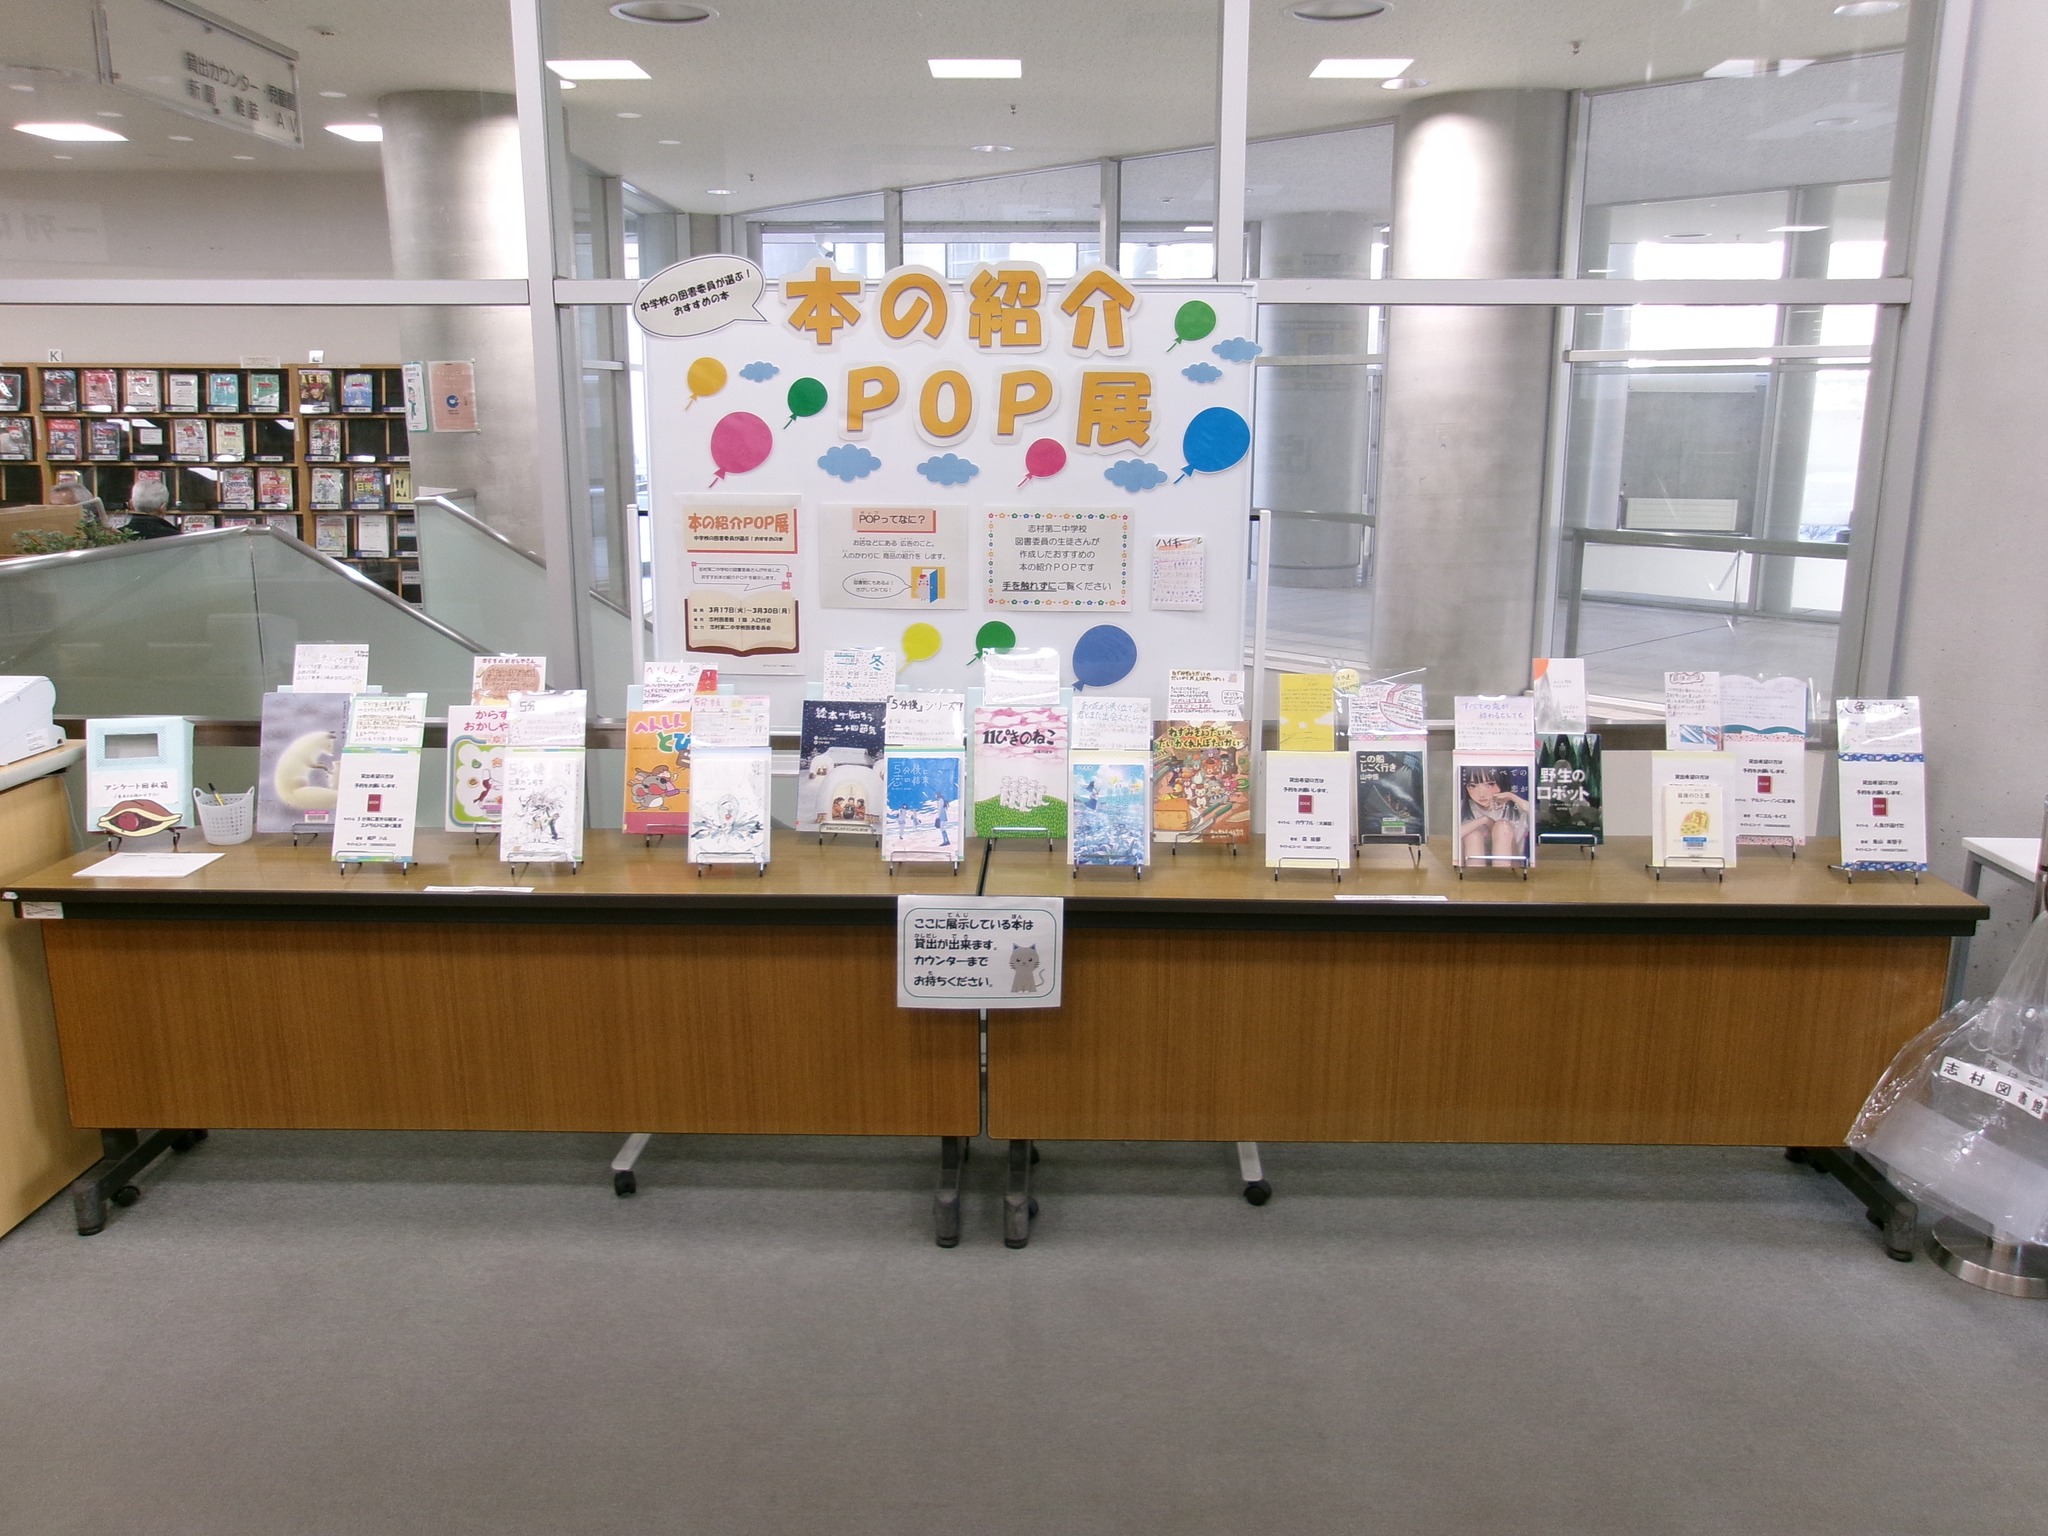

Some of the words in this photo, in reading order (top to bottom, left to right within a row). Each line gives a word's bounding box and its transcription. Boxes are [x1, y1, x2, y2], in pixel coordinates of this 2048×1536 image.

[673, 291, 730, 317] おすすめの本
[785, 267, 1135, 348] 本の紹介
[846, 365, 1153, 448] POP展
[688, 512, 789, 533] 本の紹介POP展
[1028, 525, 1087, 533] 志村第二中学校
[1015, 537, 1100, 546] 図書委員の生徒さんが
[1019, 550, 1095, 559] 作成したおすすめの
[1019, 563, 1095, 571] 本の紹介POPです
[1002, 581, 1112, 592] 手を触れずにご覧ください
[869, 653, 884, 671] 冬
[815, 707, 875, 721] 絵本で知ろう
[982, 730, 1056, 746] 11ぴきのねこ
[1360, 755, 1385, 763] この船
[1360, 763, 1397, 772] じごく行き
[1540, 767, 1586, 783] 野生の
[104, 782, 168, 791] アンケート回収箱
[1536, 786, 1590, 801] ロボット
[914, 918, 1033, 930] ここに展示している本は
[914, 939, 997, 950] 貸出が出来ます。
[914, 956, 988, 966] カウンターまで
[914, 976, 993, 987] お持ちください。
